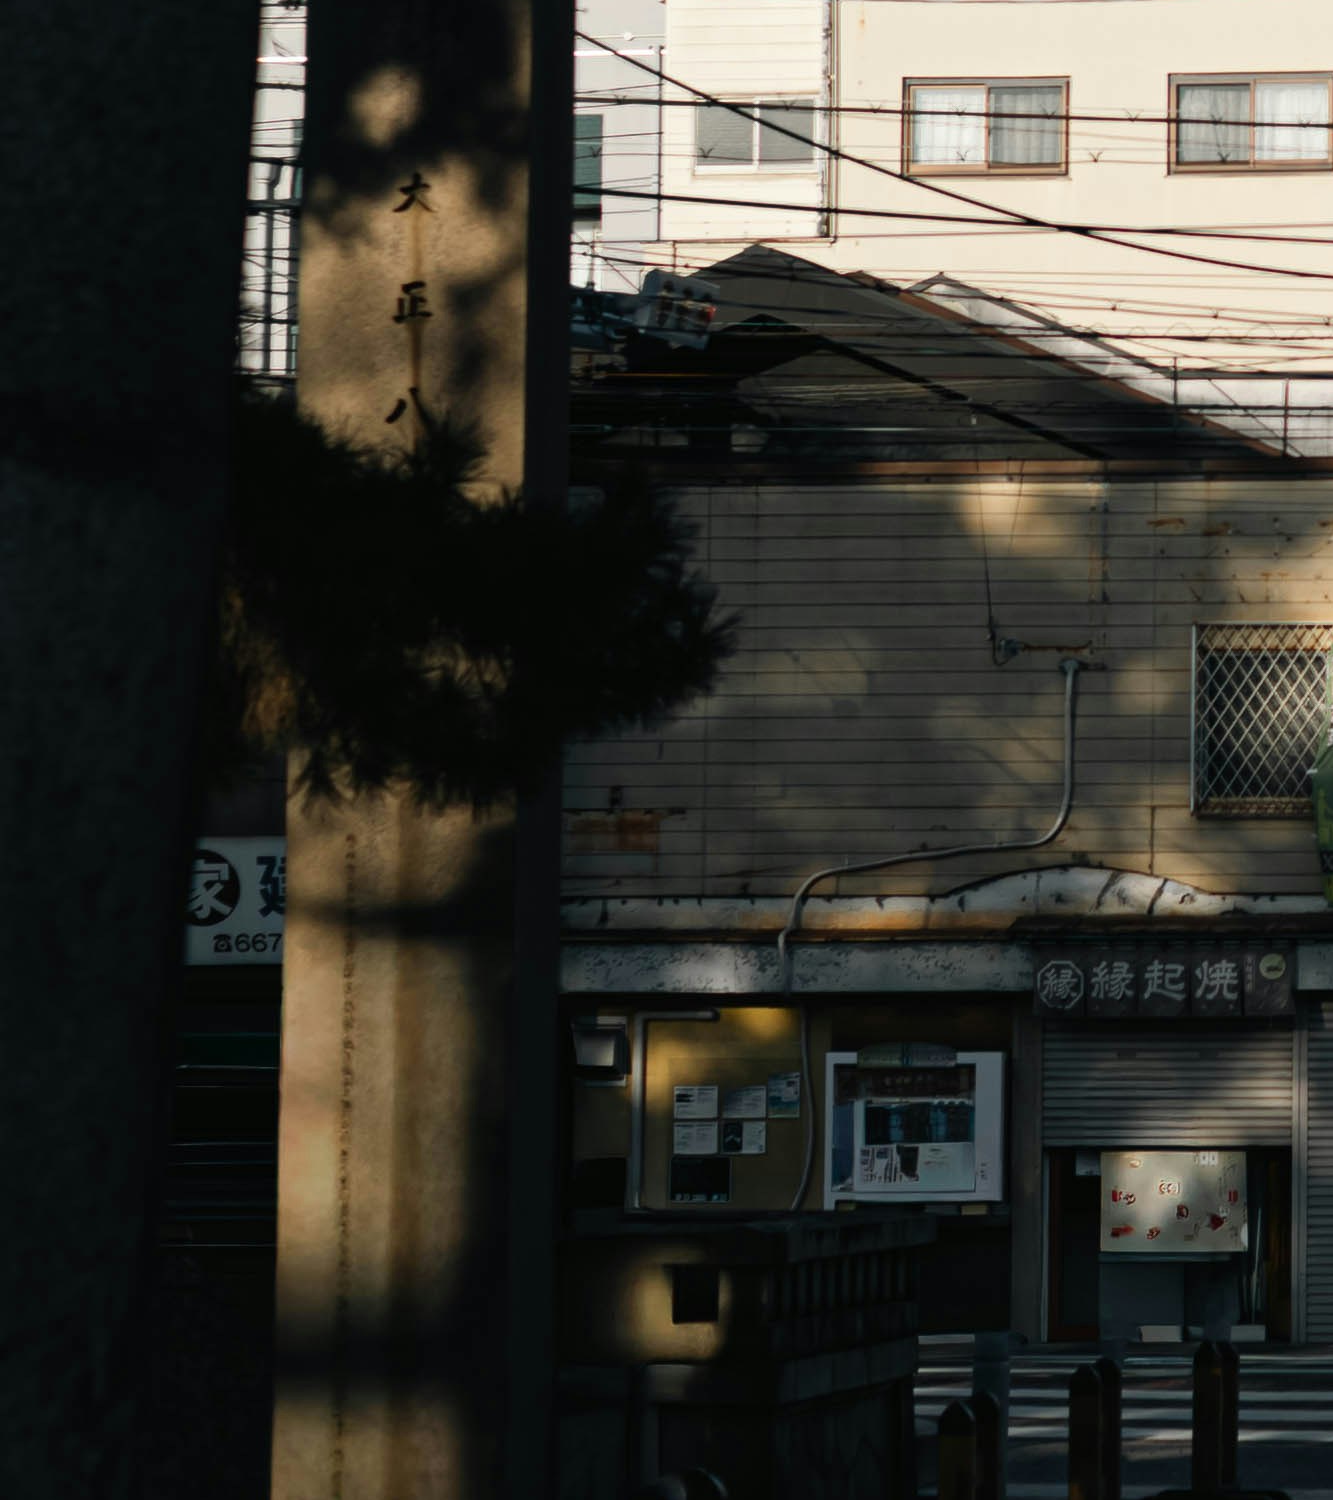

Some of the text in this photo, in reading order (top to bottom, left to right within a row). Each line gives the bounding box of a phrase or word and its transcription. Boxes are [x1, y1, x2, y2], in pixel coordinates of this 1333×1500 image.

[1042, 968, 1079, 1001] 縁
[1090, 959, 1240, 1001] 縁起焼
